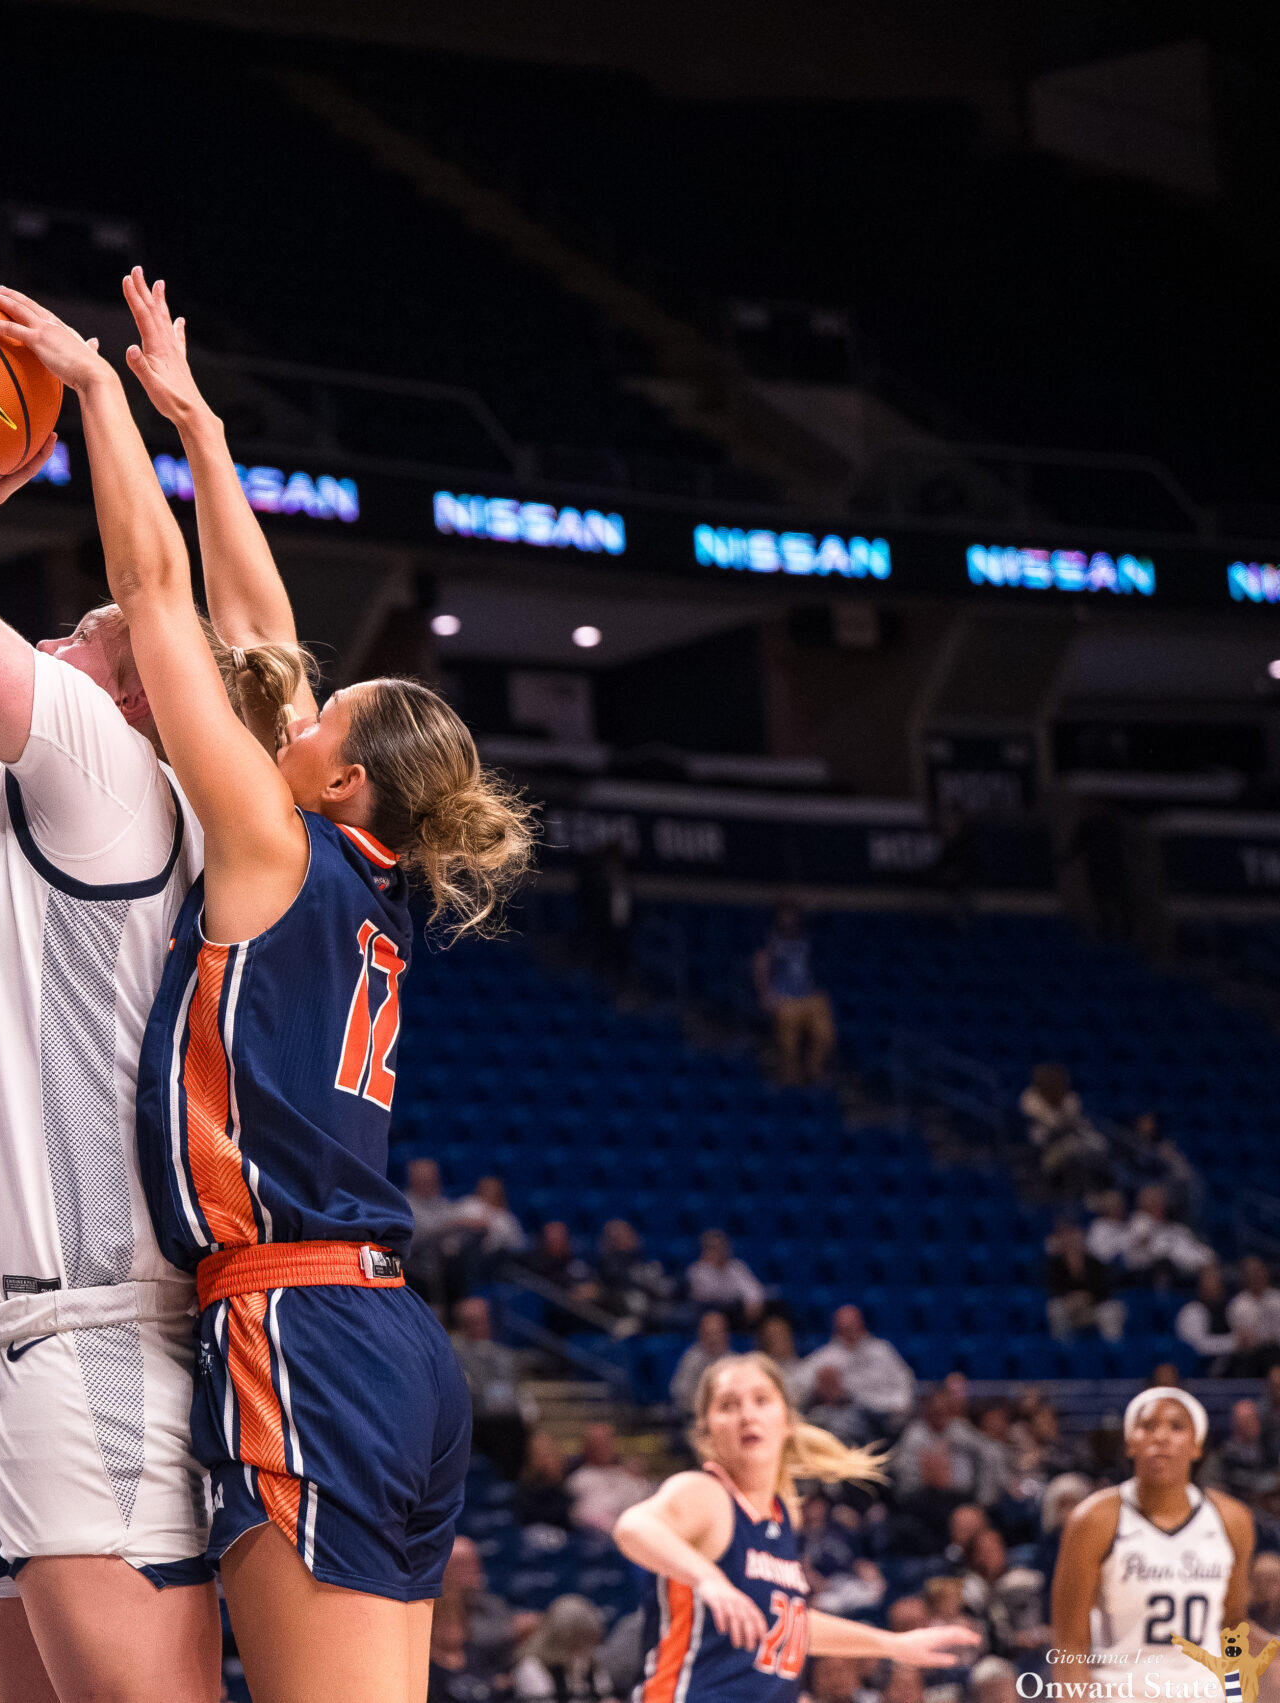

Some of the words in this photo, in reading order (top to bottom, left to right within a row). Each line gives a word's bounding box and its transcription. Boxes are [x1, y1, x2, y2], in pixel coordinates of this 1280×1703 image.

[153, 453, 360, 523] NSAN
[433, 490, 625, 555] NISSAN
[694, 524, 892, 580] NISSAN
[966, 544, 1156, 596] NISSAN
[334, 918, 406, 1112] 12
[1145, 1593, 1211, 1645] 20
